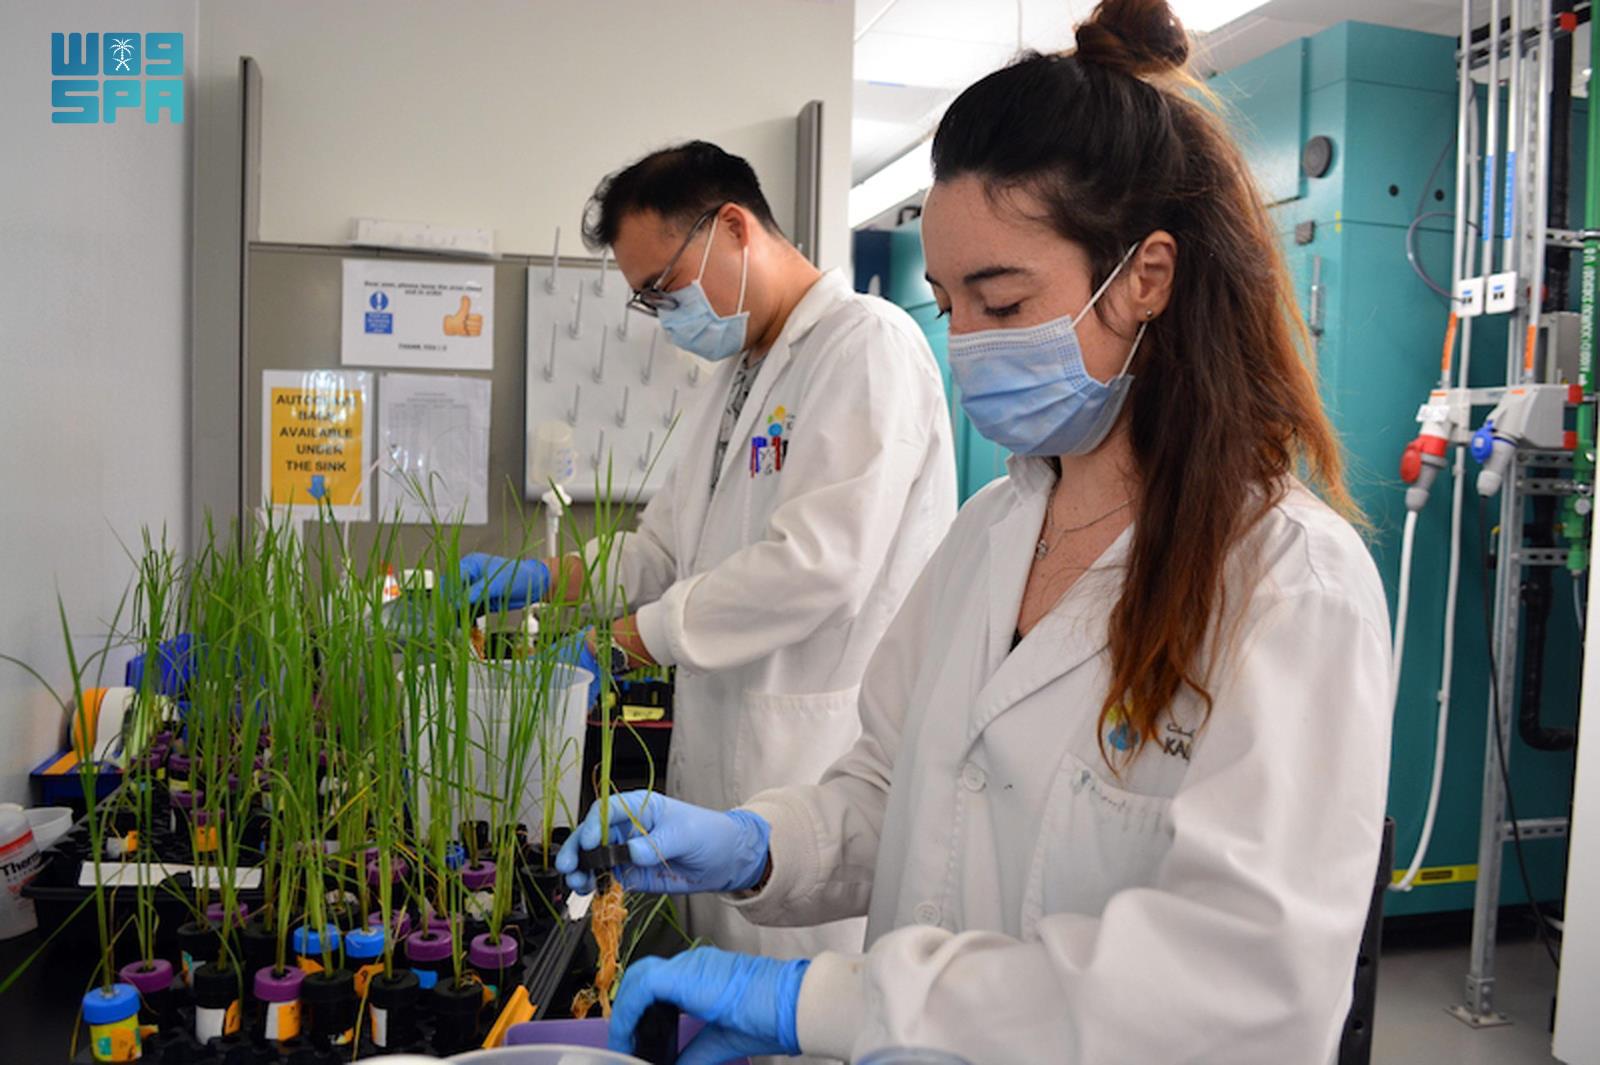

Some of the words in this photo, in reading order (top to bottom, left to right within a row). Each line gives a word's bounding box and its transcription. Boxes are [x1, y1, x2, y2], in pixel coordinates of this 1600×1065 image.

[280, 427, 353, 439] AVAILABLE
[296, 444, 343, 455] UNDER
[286, 460, 312, 471] THE
[315, 461, 347, 472] SINK
